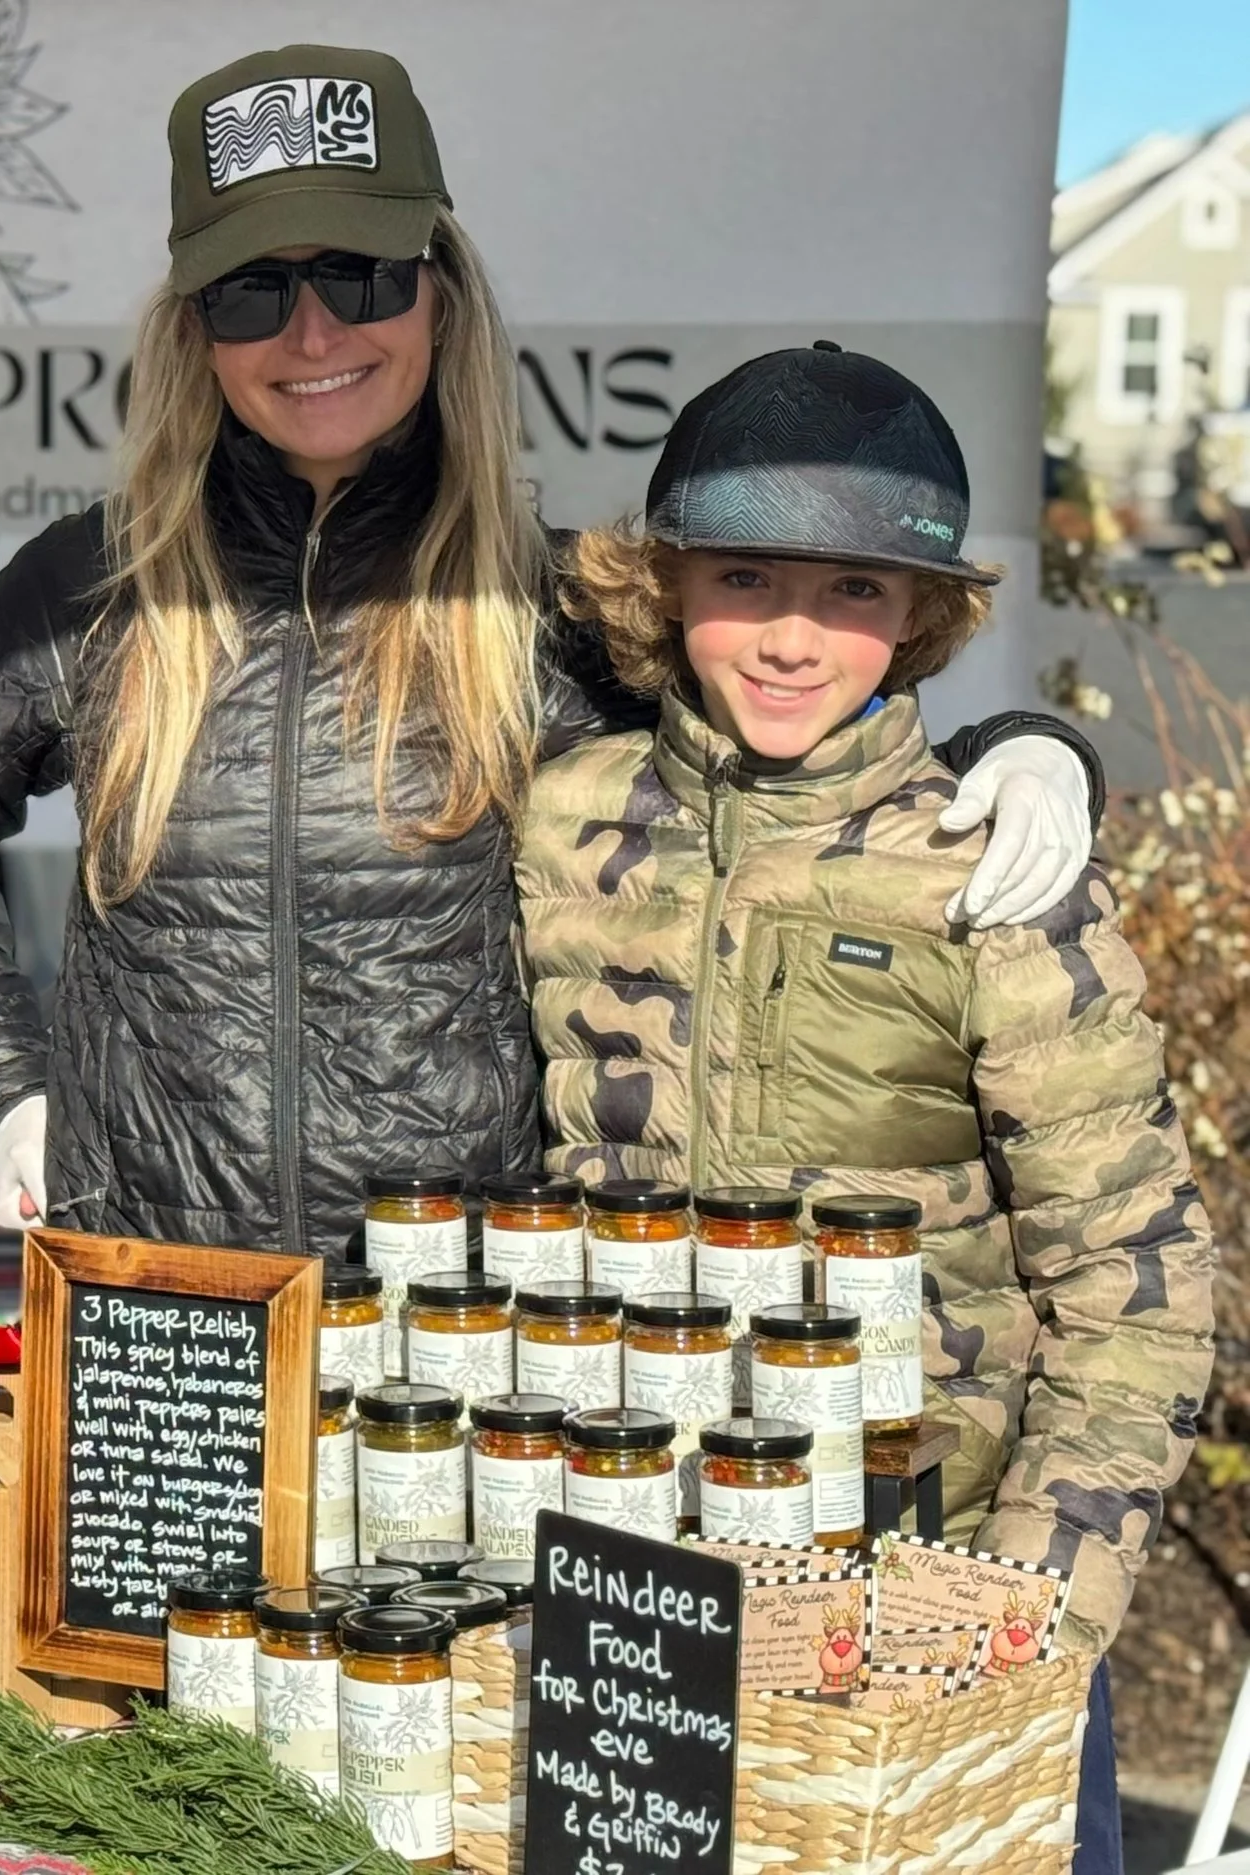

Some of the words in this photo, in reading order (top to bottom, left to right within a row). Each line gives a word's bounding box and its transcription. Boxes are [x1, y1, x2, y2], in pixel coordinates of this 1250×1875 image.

[81, 1295, 102, 1322] 3
[108, 1299, 188, 1342] Pepper
[189, 1310, 257, 1353] Relish
[74, 1336, 121, 1360] This
[127, 1342, 175, 1372] spicy
[181, 1344, 230, 1367] blend
[234, 1351, 261, 1376] of
[74, 1416, 108, 1436] well
[112, 1418, 154, 1442] with
[93, 1393, 131, 1411] mini
[134, 1399, 211, 1428] peppers
[217, 1405, 266, 1433] pairs
[73, 1463, 105, 1482] love
[111, 1464, 130, 1488] it
[99, 1441, 145, 1462] tuna
[151, 1449, 209, 1469] salad.
[213, 1455, 248, 1474] We
[99, 1488, 148, 1510] mixed
[71, 1535, 120, 1555] soups
[151, 1541, 207, 1561] stews
[548, 1545, 731, 1635] Reindeer
[909, 1551, 961, 1577] Magic
[965, 1564, 1027, 1592] Reindeer
[946, 1581, 983, 1602] Food
[766, 1609, 801, 1629] Food
[778, 1588, 837, 1610] Reindeer
[589, 1620, 672, 1680] Food
[533, 1659, 585, 1714] for
[592, 1677, 732, 1752] Christmas
[536, 1750, 603, 1799] Made
[610, 1770, 636, 1818] by
[644, 1791, 721, 1857] Brody
[587, 1811, 681, 1860] Griffin
